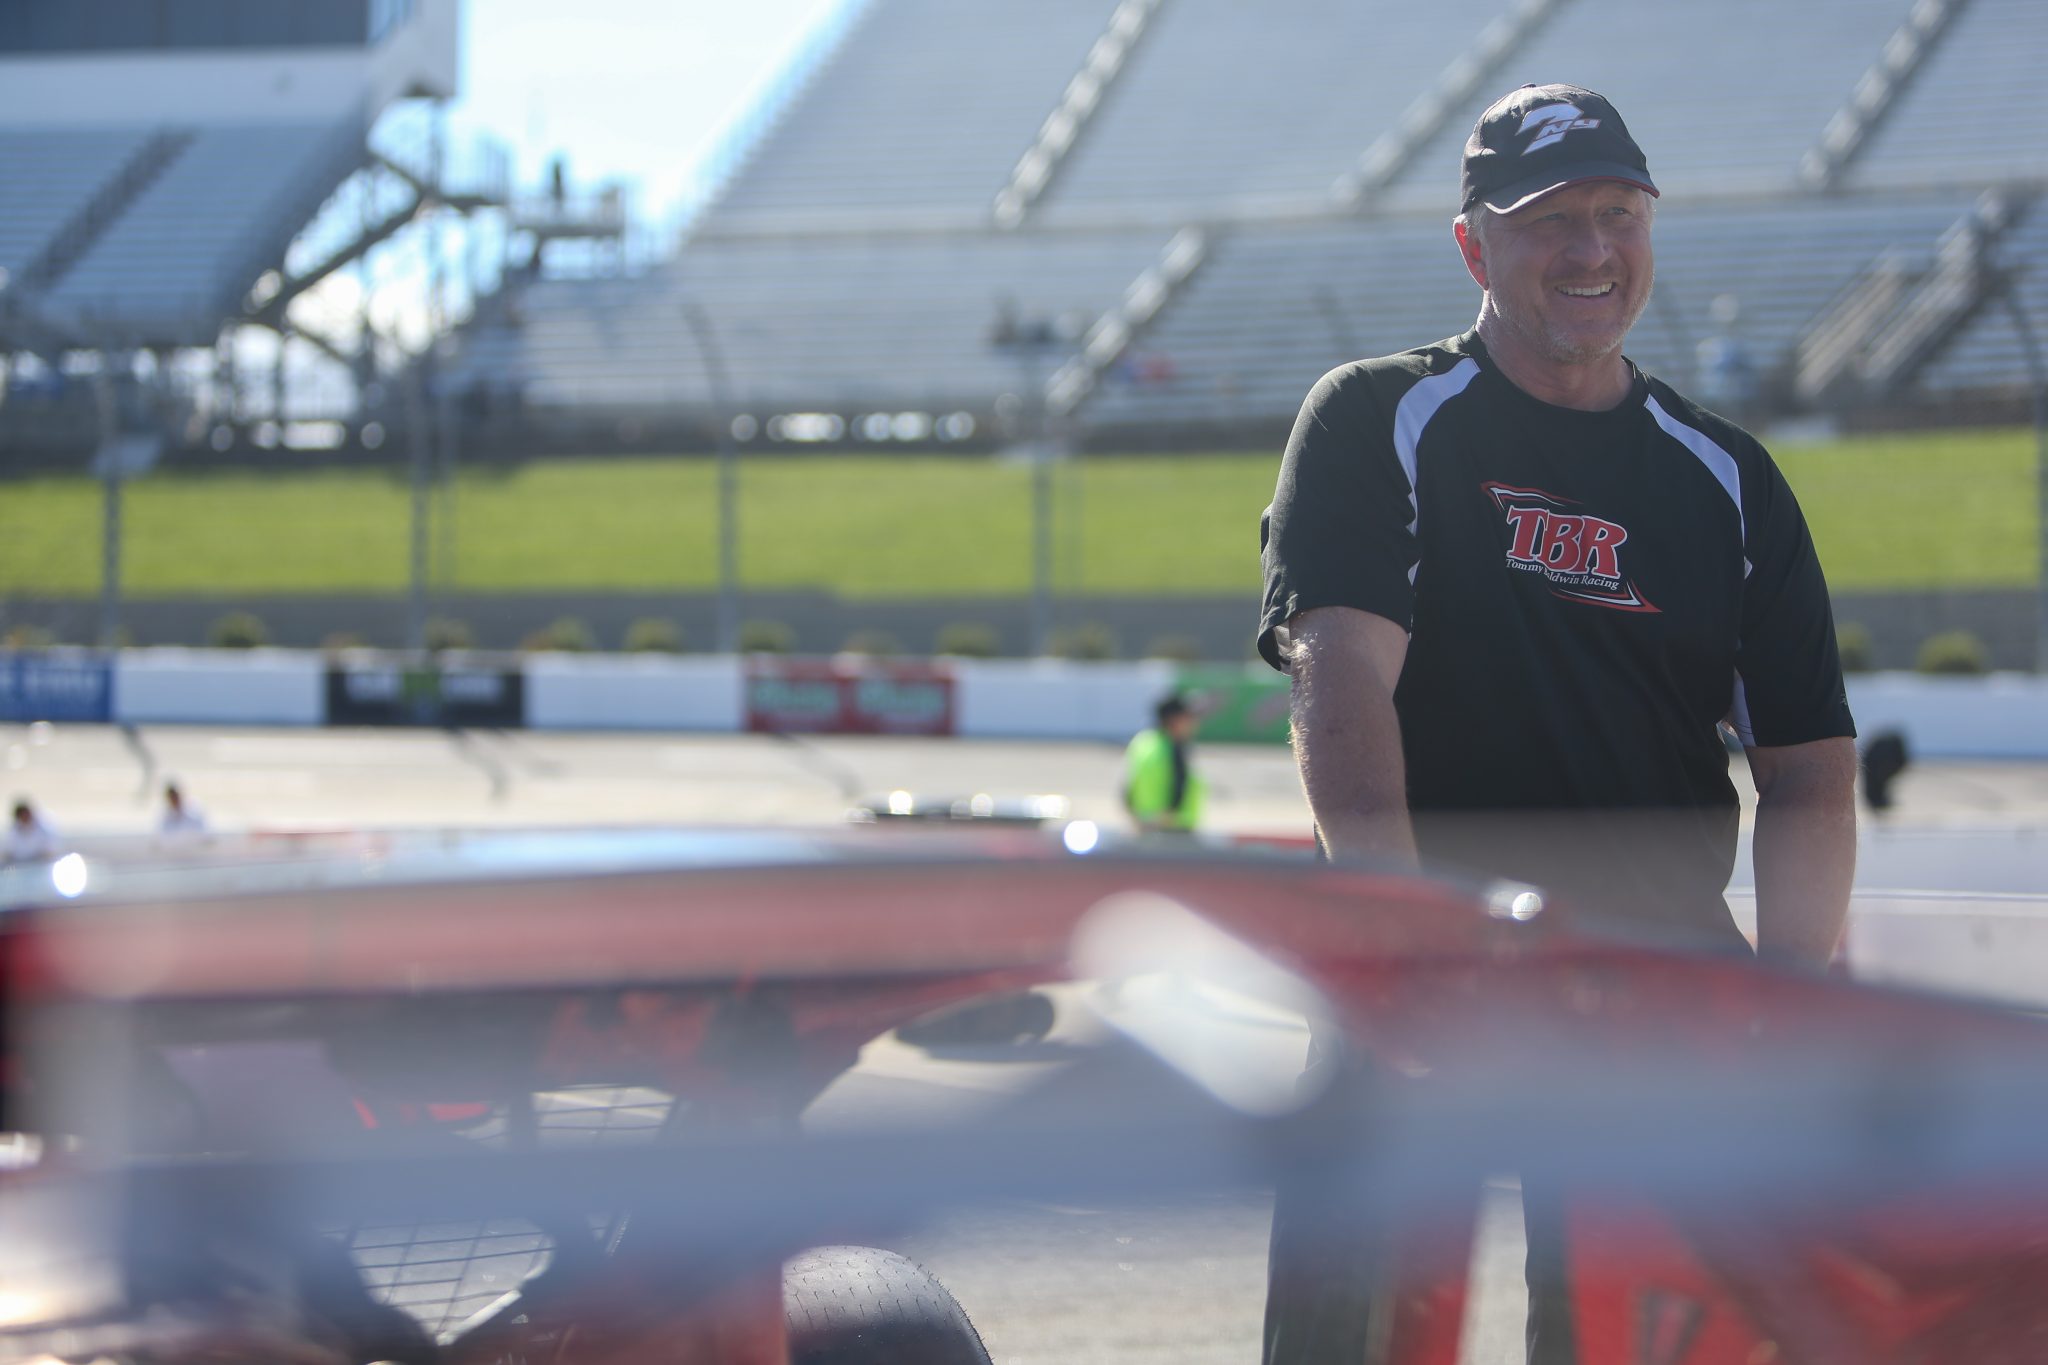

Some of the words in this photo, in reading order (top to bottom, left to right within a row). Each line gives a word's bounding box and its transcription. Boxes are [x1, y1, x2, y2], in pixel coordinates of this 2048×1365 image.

[1506, 505, 1628, 579] TBR
[1506, 559, 1543, 574] Tommy
[1581, 575, 1620, 591] Racing
